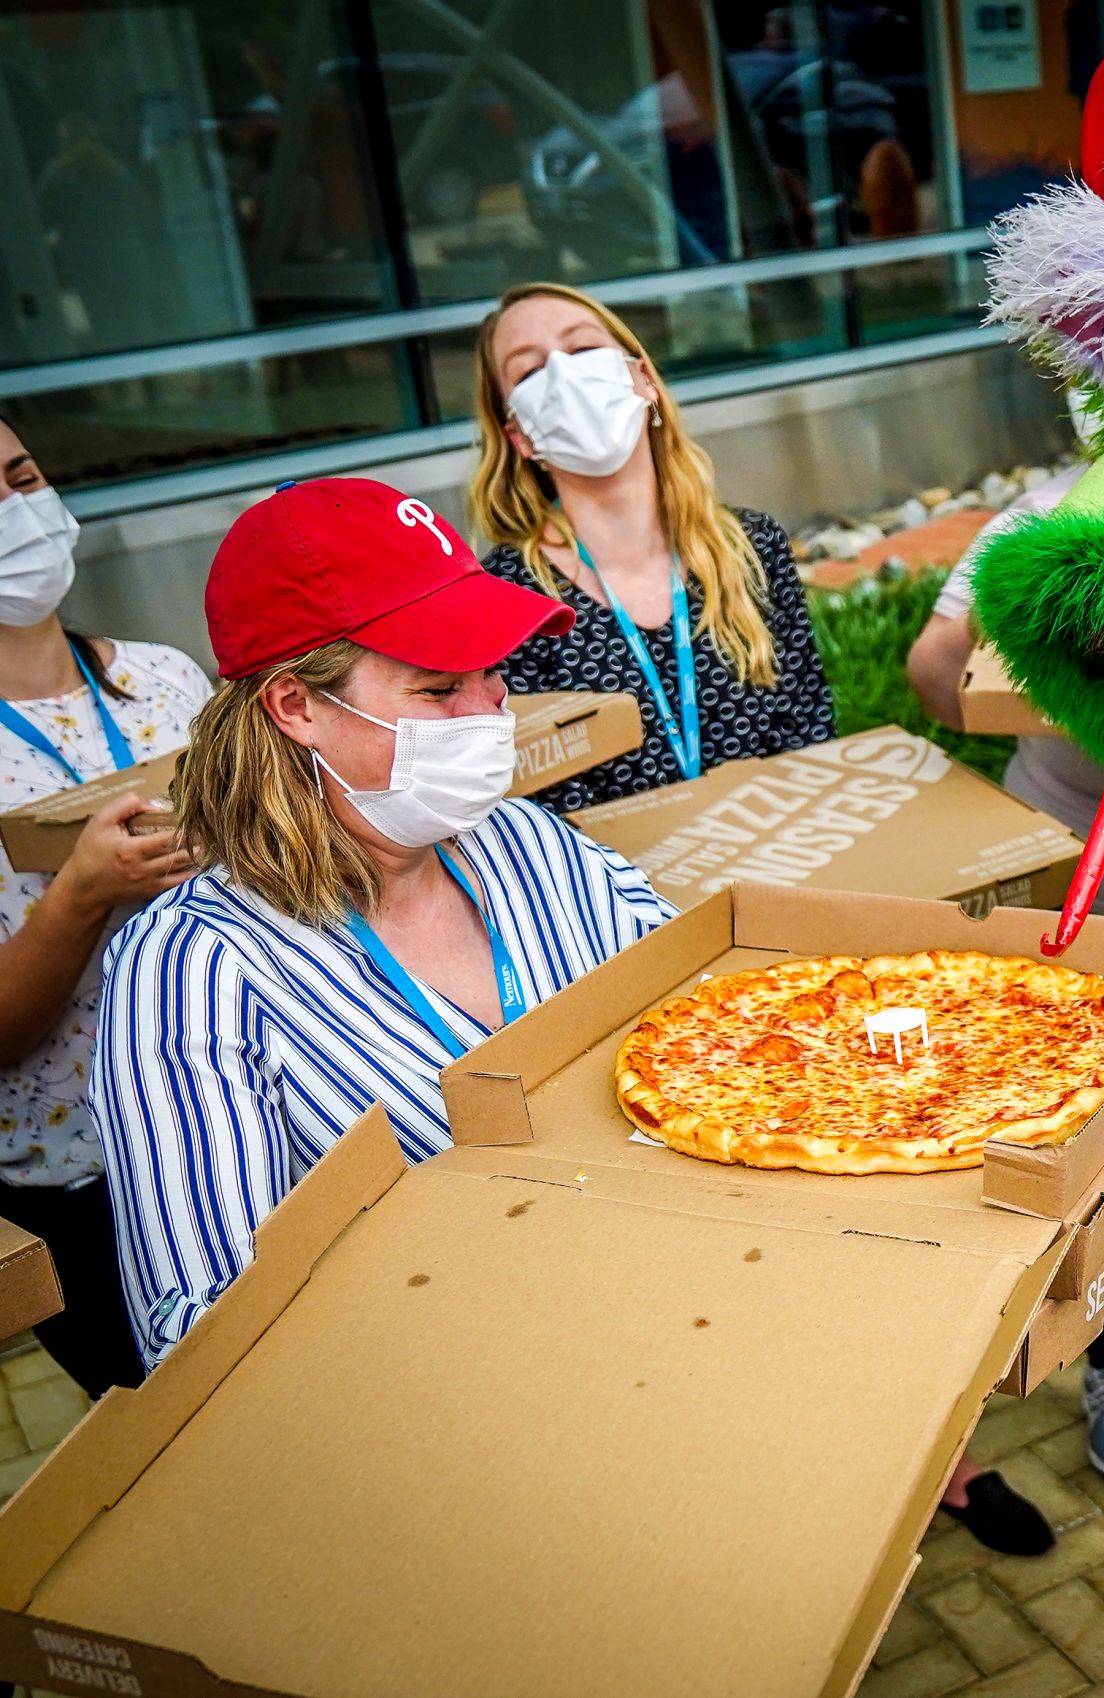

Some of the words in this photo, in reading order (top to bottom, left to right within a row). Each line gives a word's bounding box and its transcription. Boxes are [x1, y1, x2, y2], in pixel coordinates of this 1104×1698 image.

[397, 498, 453, 556] P
[515, 733, 567, 781] PIZZA
[673, 758, 845, 845] PIZZA
[656, 842, 738, 887] SALAD
[33, 1627, 132, 1669] CATERING
[47, 1655, 143, 1696] DELIVERY
